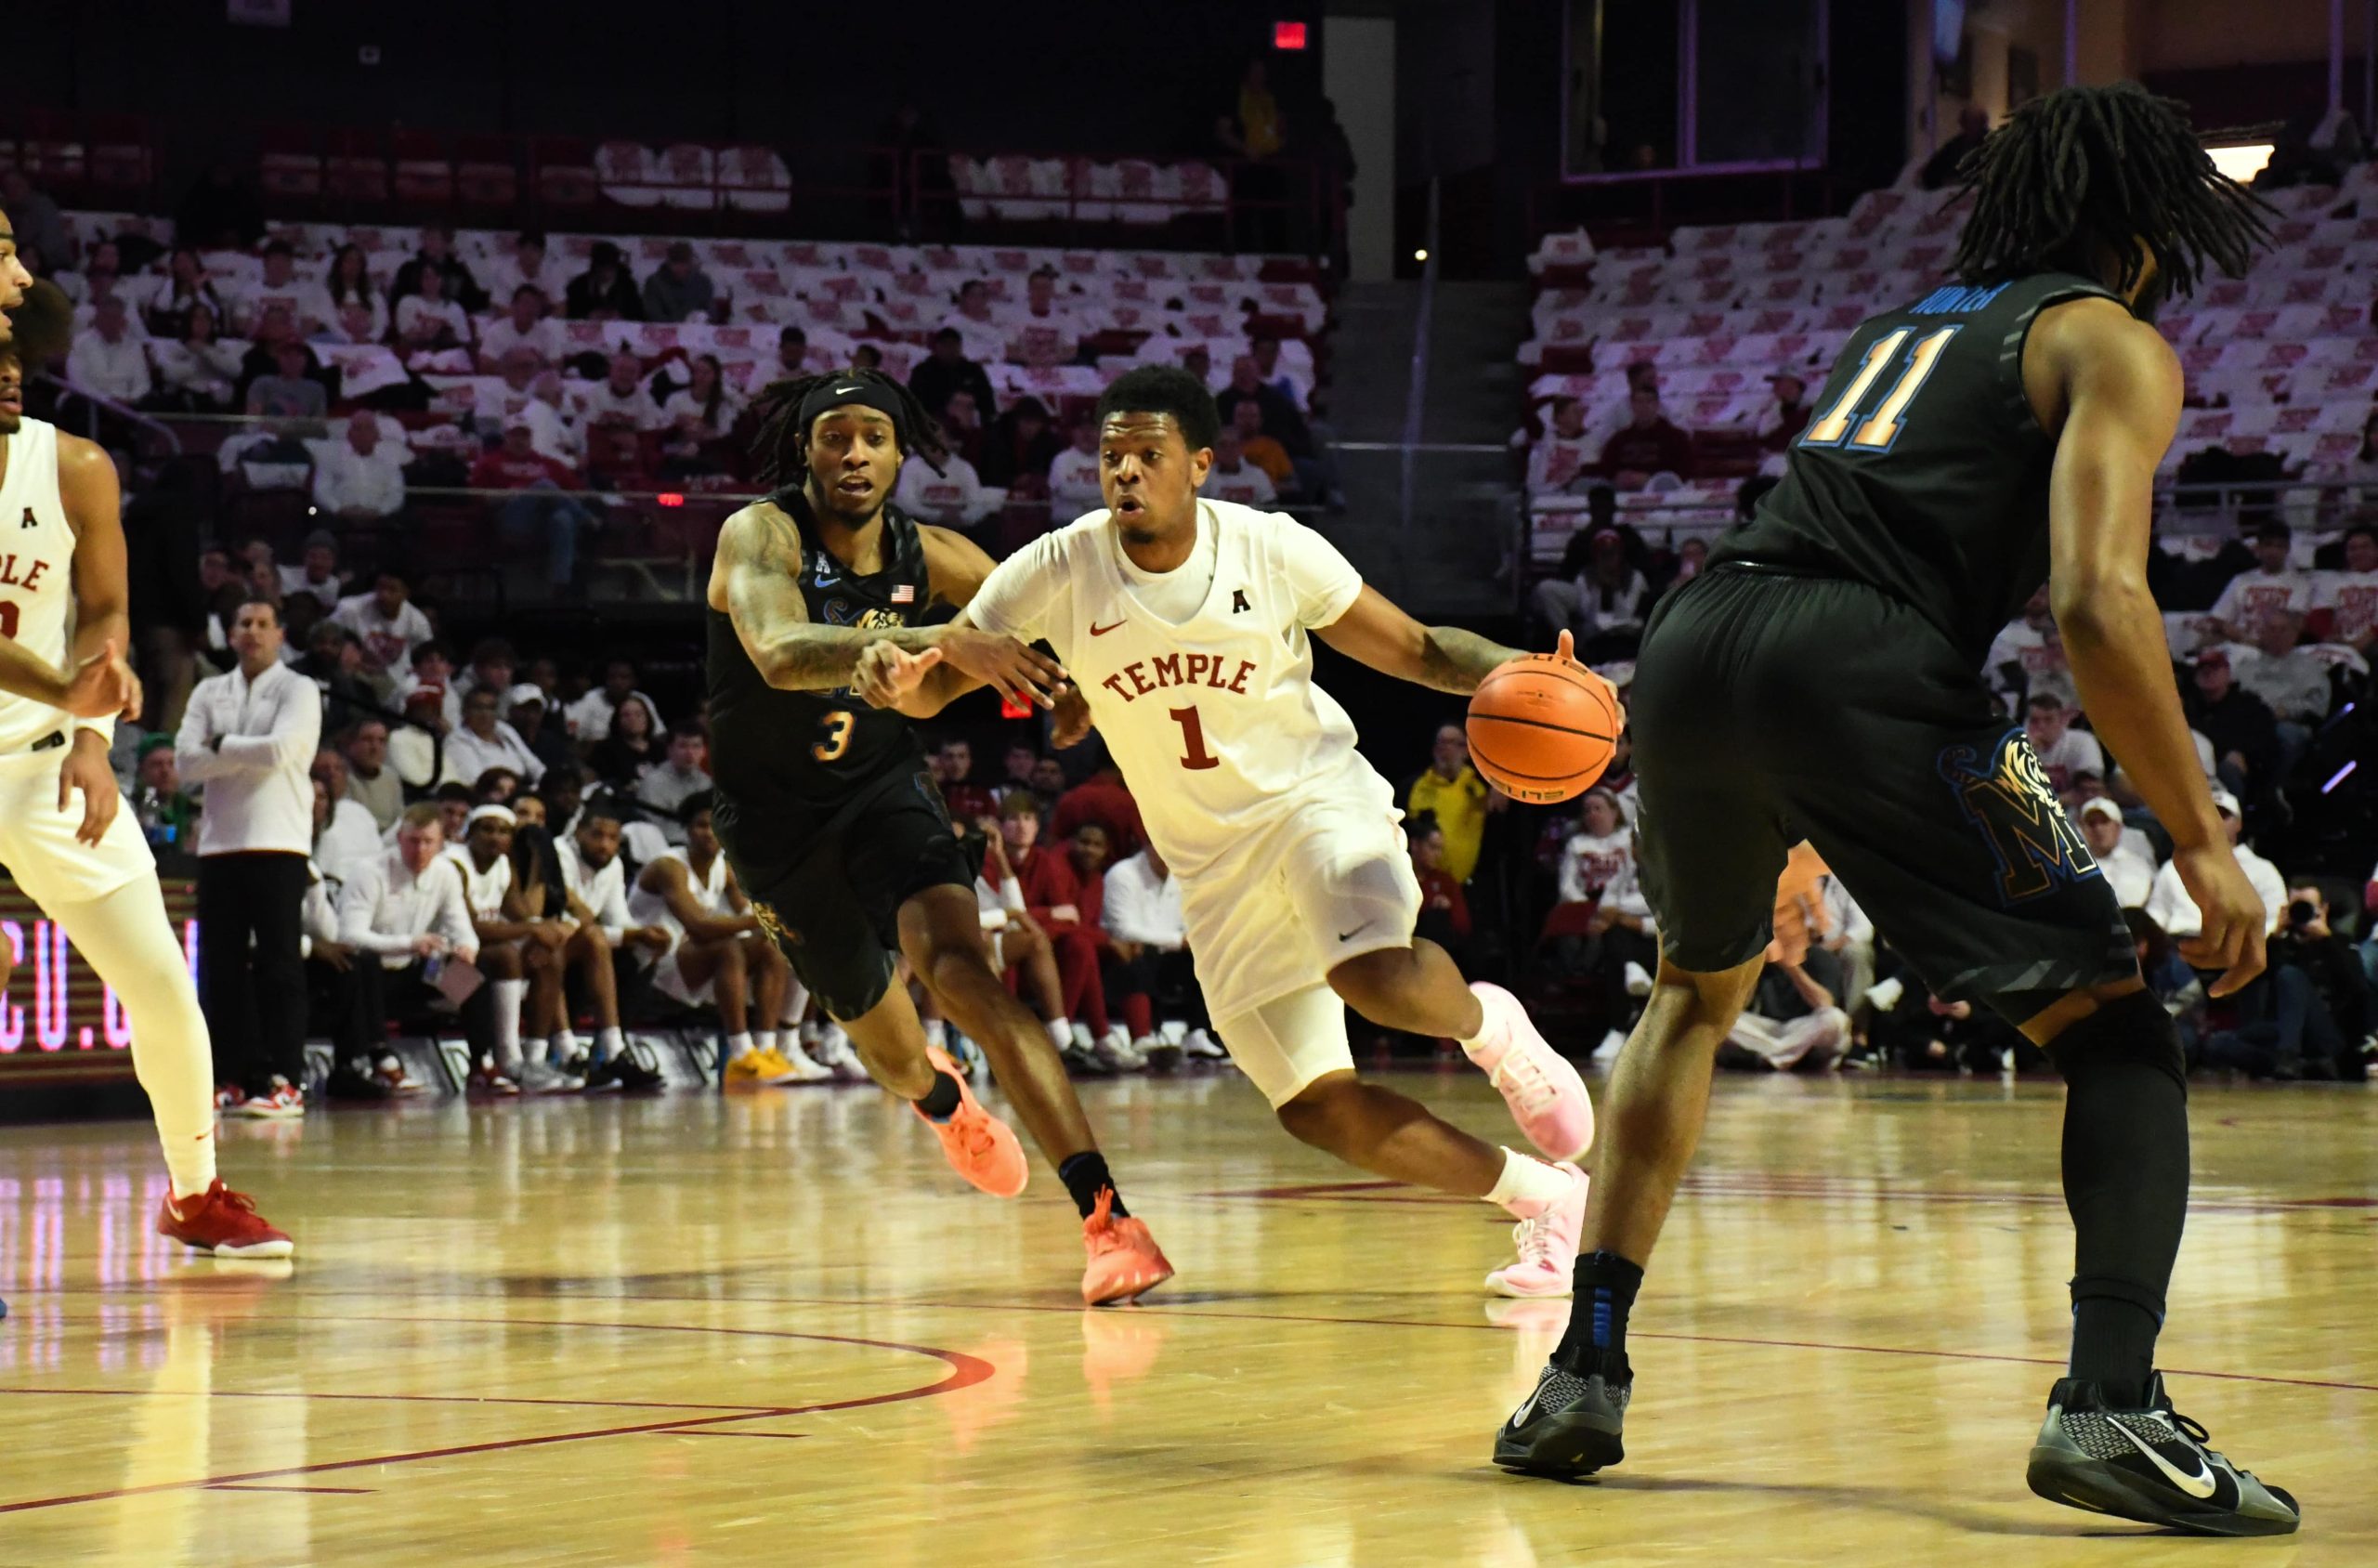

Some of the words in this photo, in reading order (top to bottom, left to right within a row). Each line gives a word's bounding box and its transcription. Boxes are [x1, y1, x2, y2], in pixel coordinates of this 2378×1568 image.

[1797, 324, 1965, 454] 11
[21, 506, 38, 529] A
[0, 554, 49, 592] LE
[1232, 589, 1251, 614] A
[1102, 652, 1257, 702] TEMPLE
[810, 710, 856, 764] 3
[1169, 705, 1220, 770] 1
